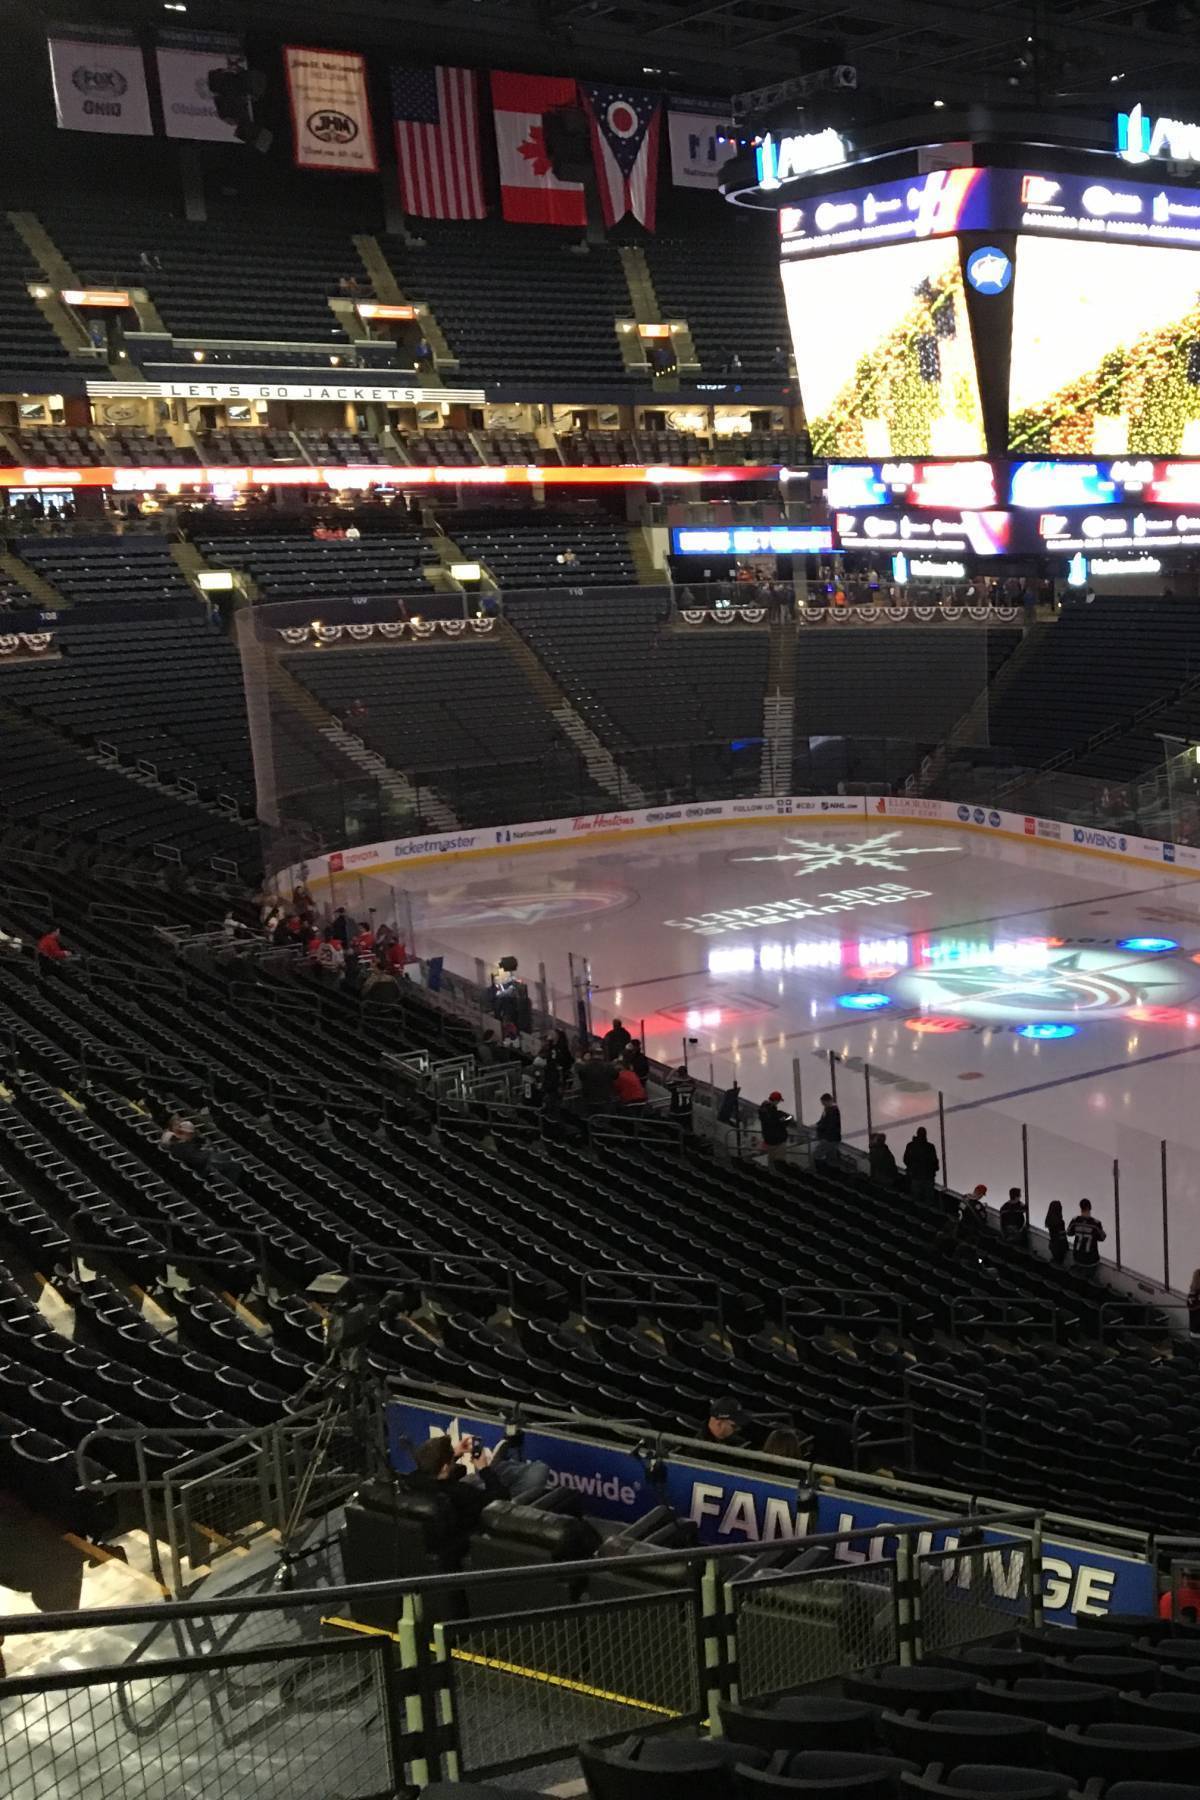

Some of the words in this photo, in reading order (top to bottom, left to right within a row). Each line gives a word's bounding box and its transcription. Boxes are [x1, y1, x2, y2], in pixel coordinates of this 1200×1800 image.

[315, 115, 352, 135] JHM
[259, 386, 288, 398] GO
[303, 387, 416, 400] JACKETS
[733, 805, 762, 813] FOLLOW
[571, 816, 591, 831] Tim
[592, 812, 635, 829] Hortons
[393, 834, 477, 857] ticketmaster
[1085, 831, 1117, 849] WBNS
[345, 849, 379, 865] TOYOTA
[545, 1468, 635, 1506] onwide
[690, 1481, 811, 1544] FAN
